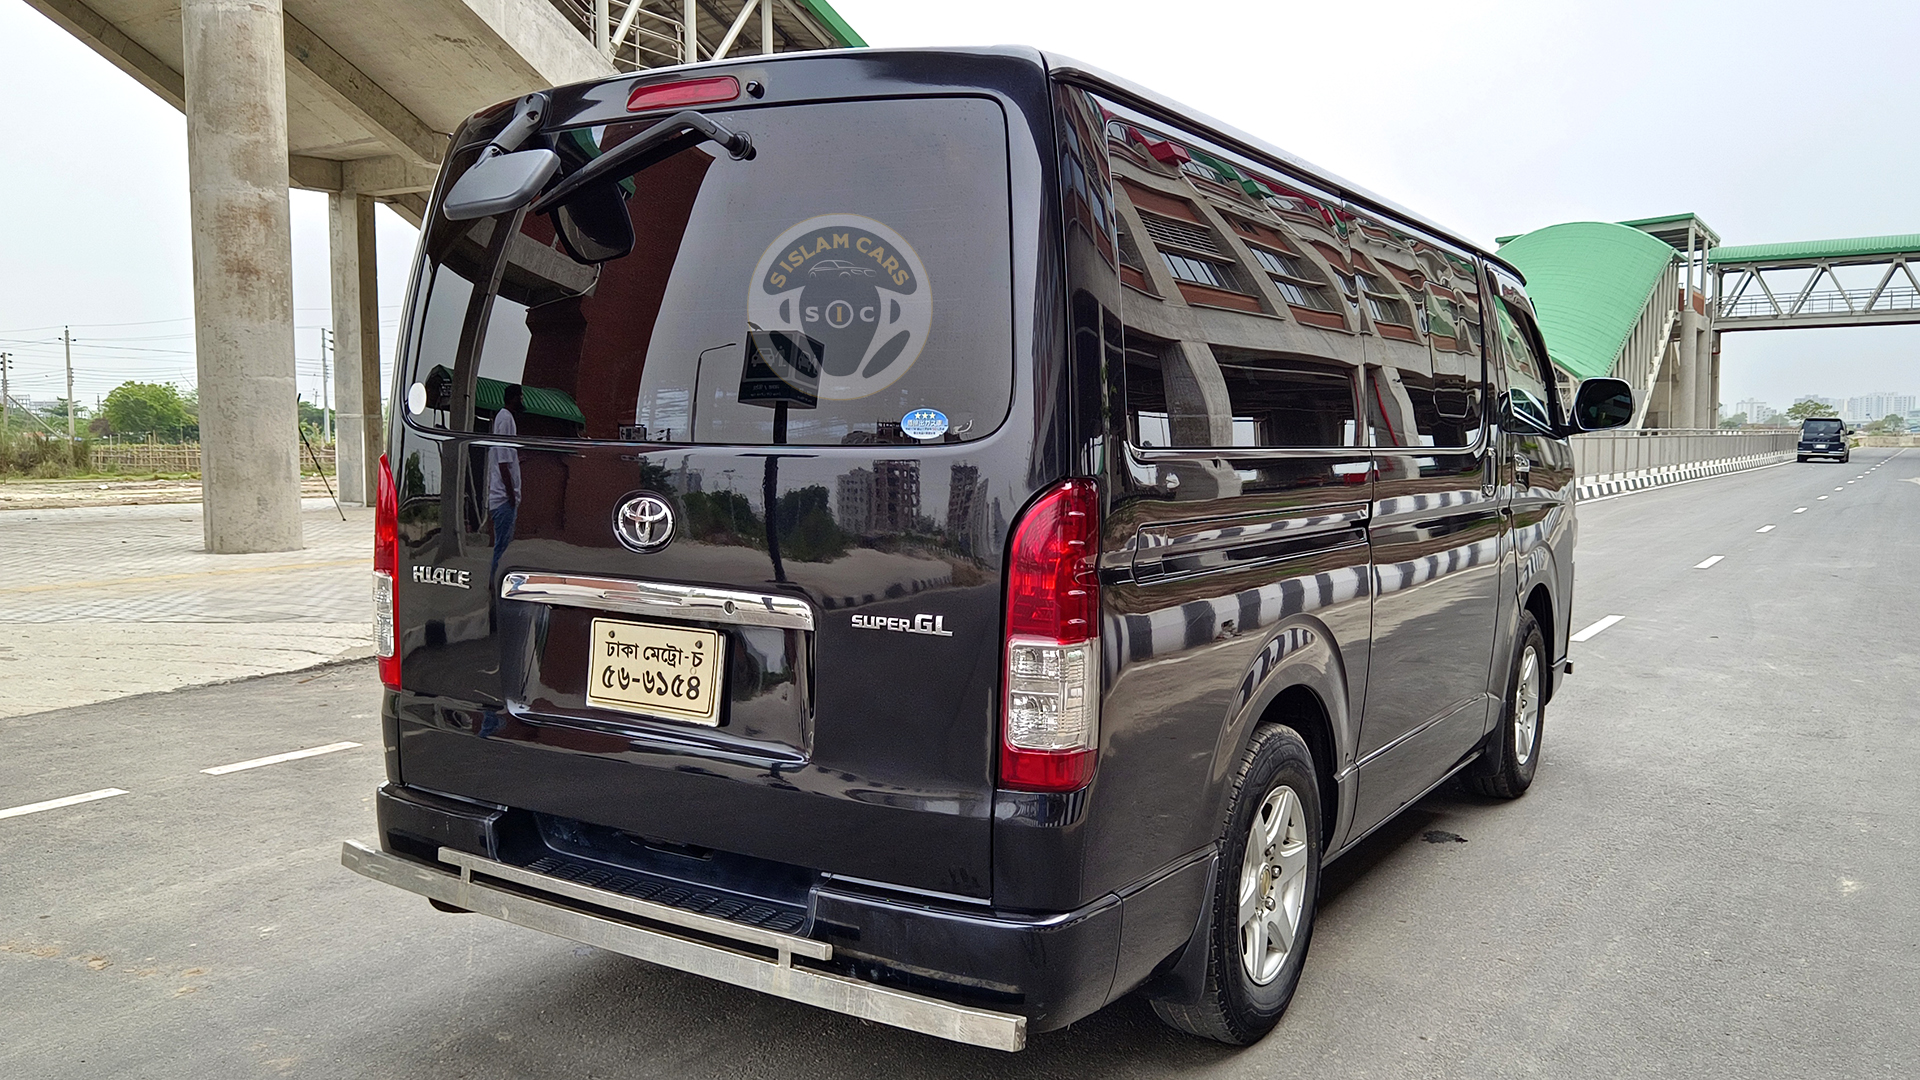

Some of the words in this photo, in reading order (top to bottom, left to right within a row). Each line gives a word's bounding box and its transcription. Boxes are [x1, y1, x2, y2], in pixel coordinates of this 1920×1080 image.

[412, 565, 471, 590] HIACE
[605, 640, 640, 660] ঢাকা
[602, 664, 701, 700] ৫৬-৬১৫৪
